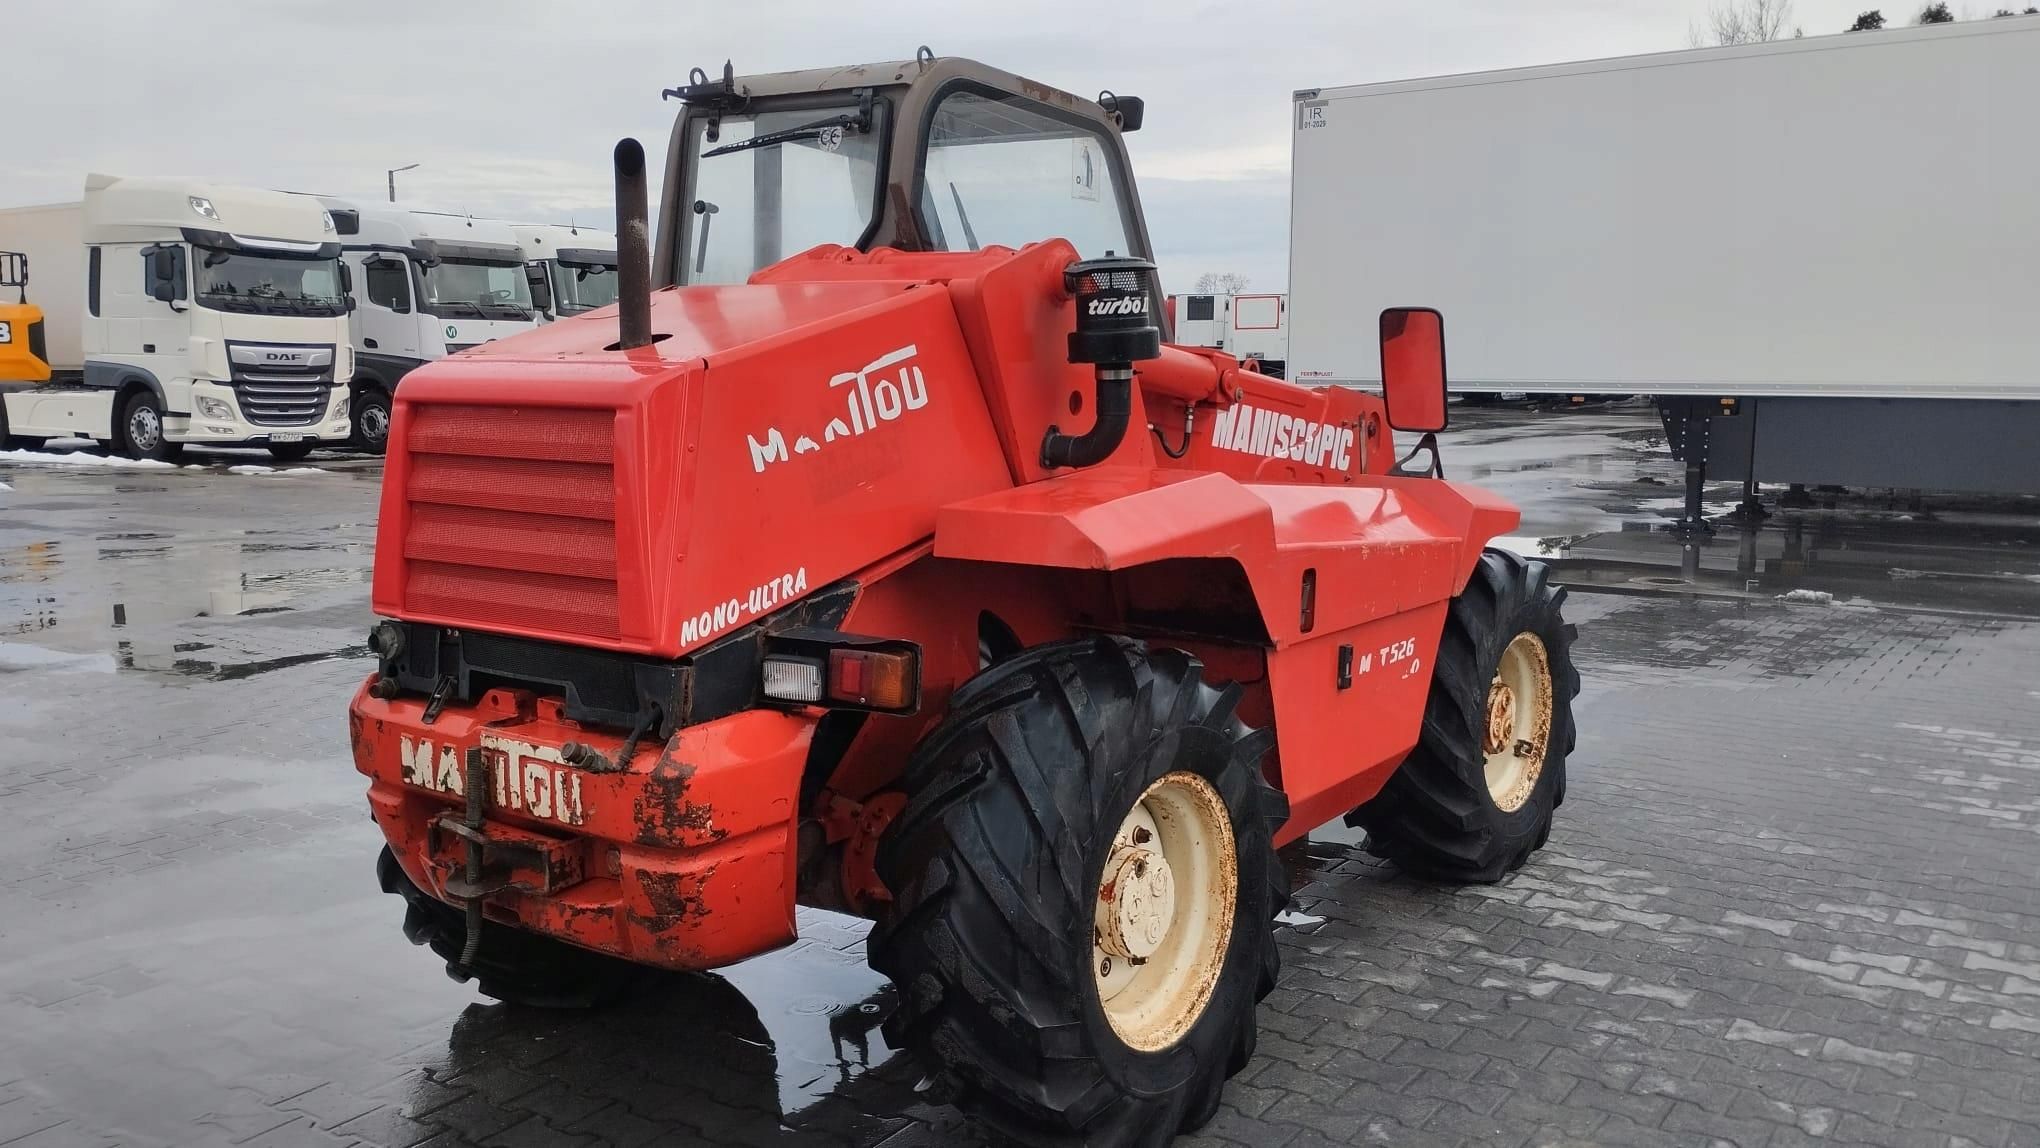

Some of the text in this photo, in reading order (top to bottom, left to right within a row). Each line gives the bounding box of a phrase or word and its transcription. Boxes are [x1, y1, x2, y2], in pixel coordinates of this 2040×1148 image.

[1309, 107, 1322, 119] IR
[1088, 296, 1141, 315] turbo
[266, 353, 302, 361] DAF
[1212, 402, 1354, 472] MANISCOPIC
[680, 567, 807, 648] MONO-ULTRA
[400, 734, 583, 825] MAITOU
